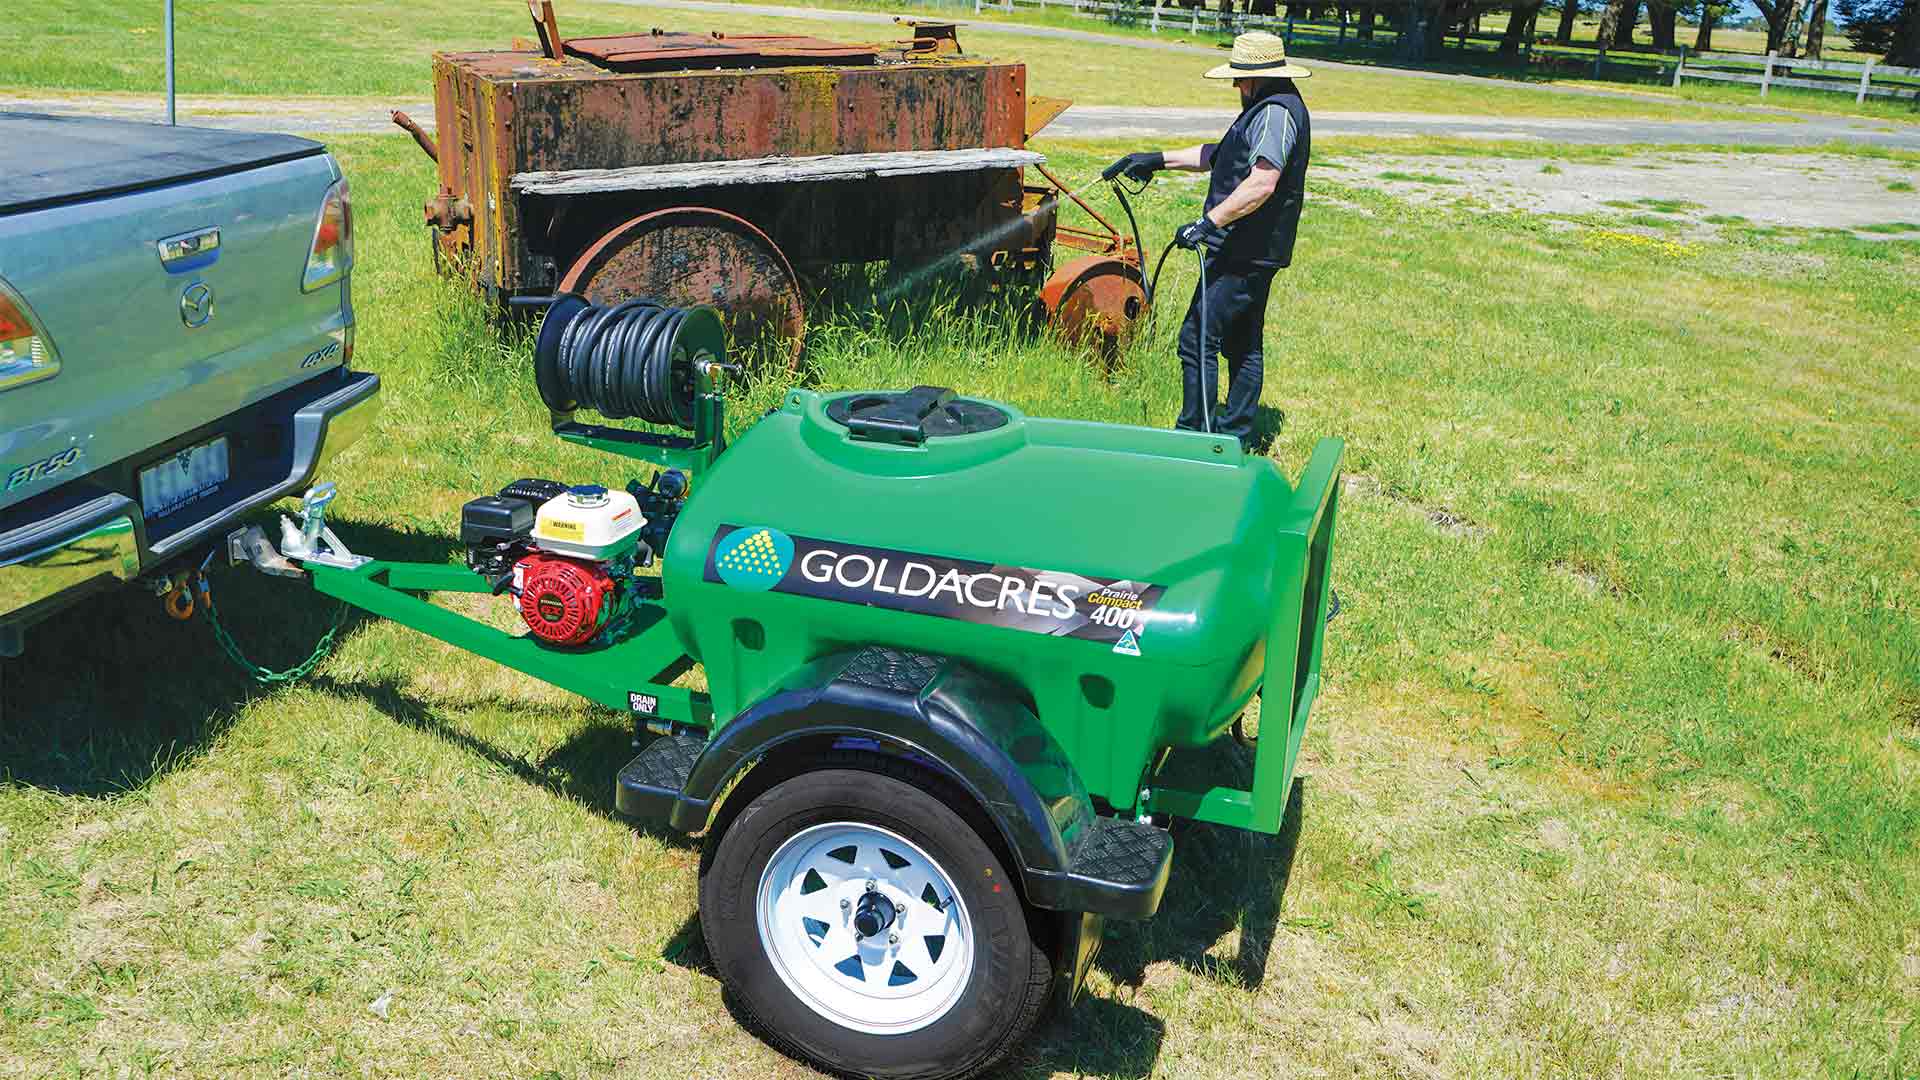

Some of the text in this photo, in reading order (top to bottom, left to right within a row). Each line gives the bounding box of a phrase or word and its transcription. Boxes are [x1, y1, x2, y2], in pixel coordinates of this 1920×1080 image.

[7, 447, 81, 490] BT-50
[552, 520, 577, 530] WARNING
[800, 549, 1079, 620] GOLDACRES
[1087, 592, 1143, 609] Compact
[1101, 588, 1138, 600] Prairie
[1089, 604, 1137, 629] 400
[630, 693, 657, 706] DRAIN
[632, 702, 655, 713] ONLY
